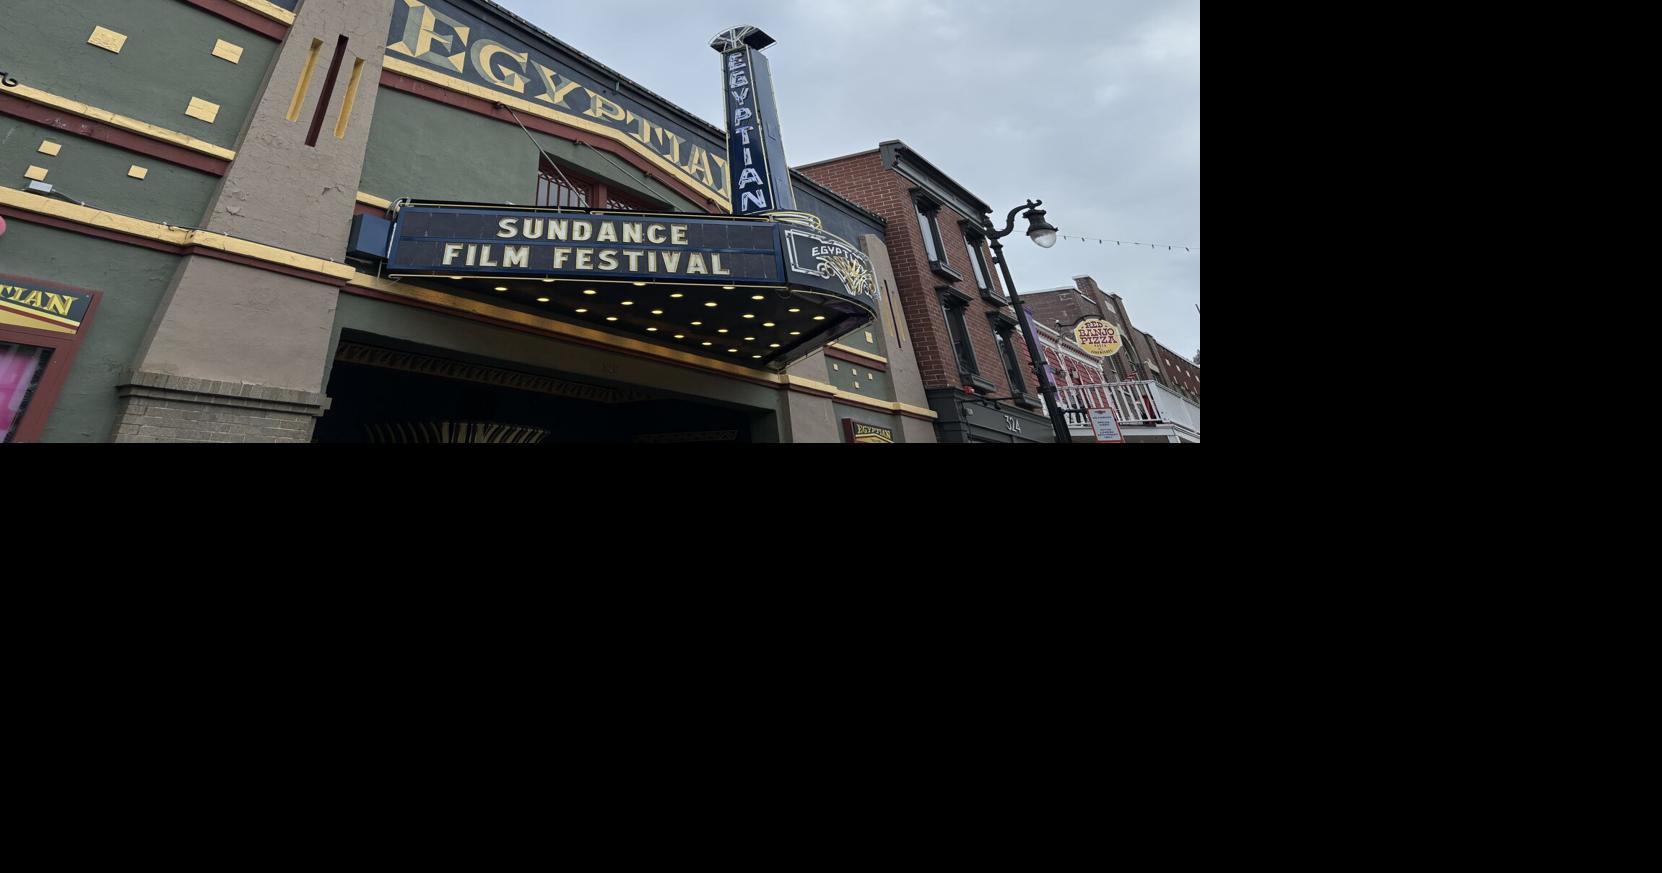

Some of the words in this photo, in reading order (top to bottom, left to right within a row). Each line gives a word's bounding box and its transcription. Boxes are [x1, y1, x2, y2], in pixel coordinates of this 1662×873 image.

[728, 52, 767, 212] EGYPTIAN
[496, 217, 689, 245] SUNDANCE
[442, 242, 530, 268] FILM
[553, 247, 731, 276] FESTIVAL
[1078, 328, 1115, 337] BANJO
[1084, 321, 1104, 329] RED
[1080, 335, 1118, 345] PIZZA
[1003, 414, 1022, 434] 324
